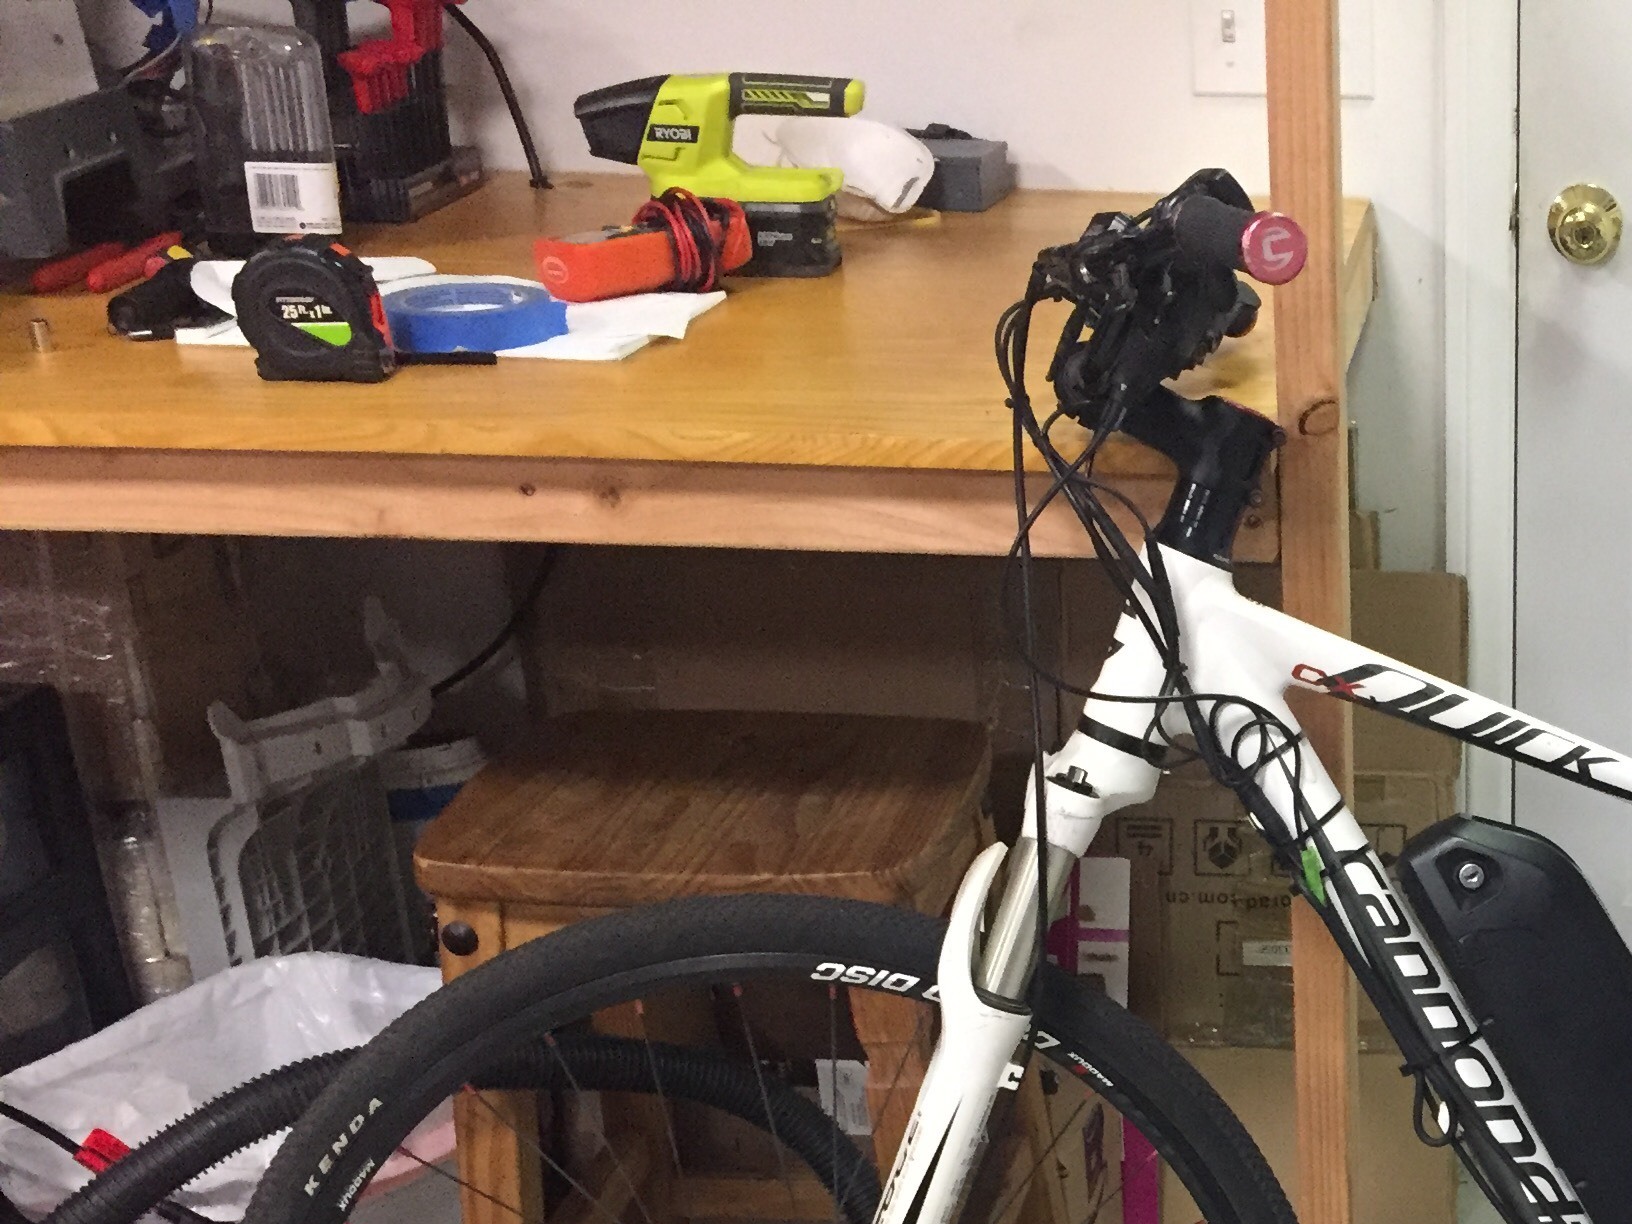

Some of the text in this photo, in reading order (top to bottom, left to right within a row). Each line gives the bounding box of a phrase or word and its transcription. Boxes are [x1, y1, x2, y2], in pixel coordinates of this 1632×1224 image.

[653, 126, 692, 141] RYOBI
[810, 962, 920, 992] DISC
[303, 1097, 384, 1197] KENDA
